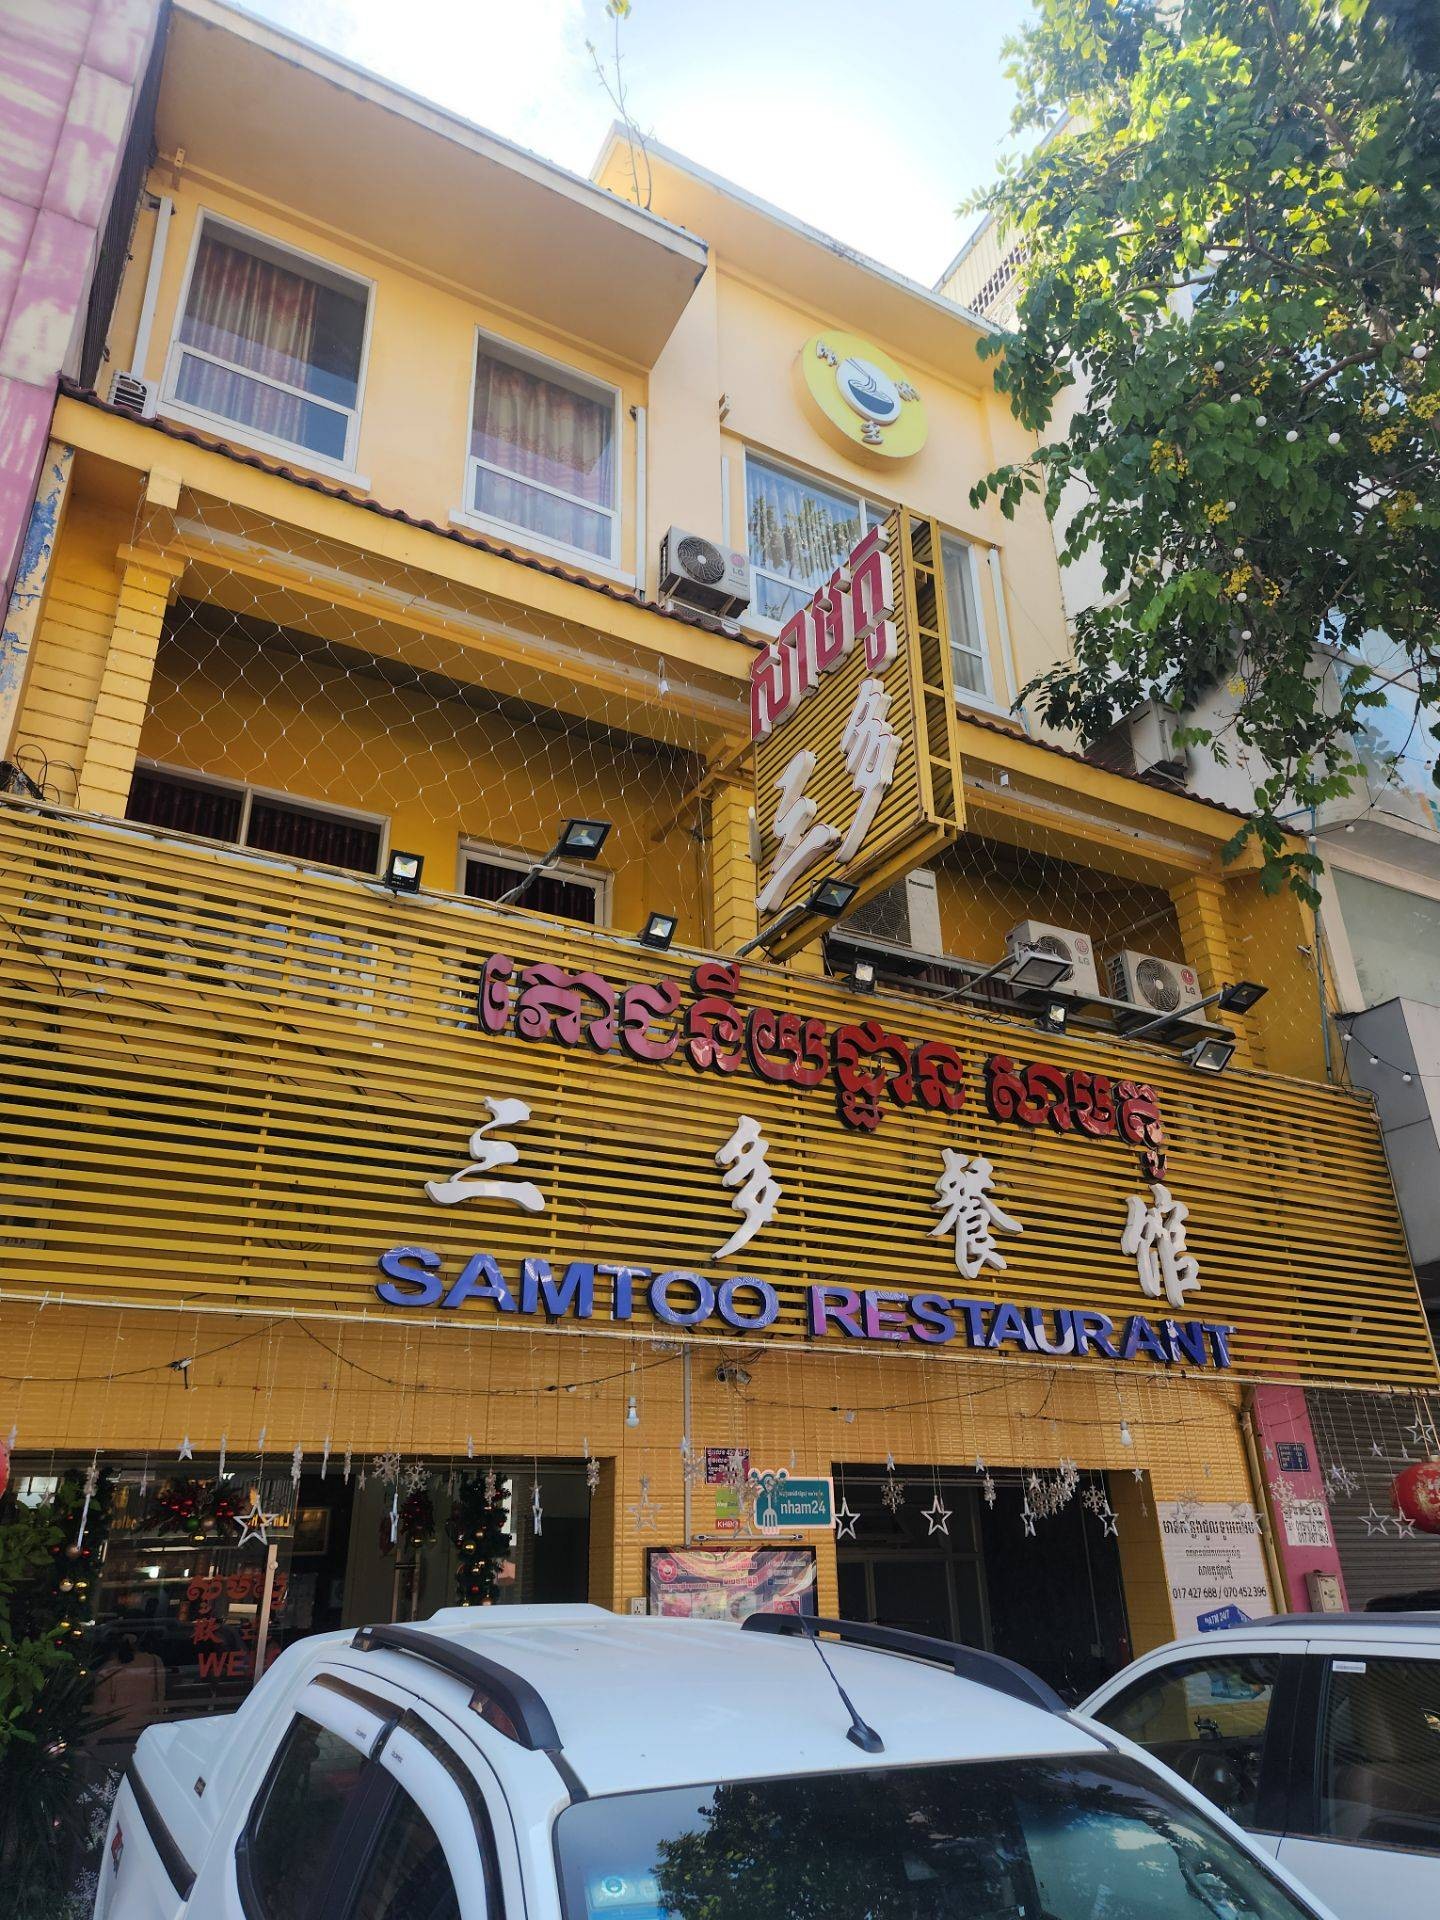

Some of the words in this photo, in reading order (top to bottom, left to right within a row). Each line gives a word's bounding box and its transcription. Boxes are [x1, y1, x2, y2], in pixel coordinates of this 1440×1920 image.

[732, 566, 745, 577] LG
[1078, 956, 1091, 966] LG
[1184, 984, 1197, 996] LG
[375, 1246, 780, 1329] SAMTOO
[807, 1285, 1237, 1369] RESTAURANT
[780, 1500, 826, 1514] nham24
[1172, 1587, 1187, 1599] 017
[1187, 1587, 1201, 1599] 427
[1223, 1586, 1238, 1598] 070
[1238, 1586, 1253, 1598] 452
[1253, 1585, 1267, 1597] 396
